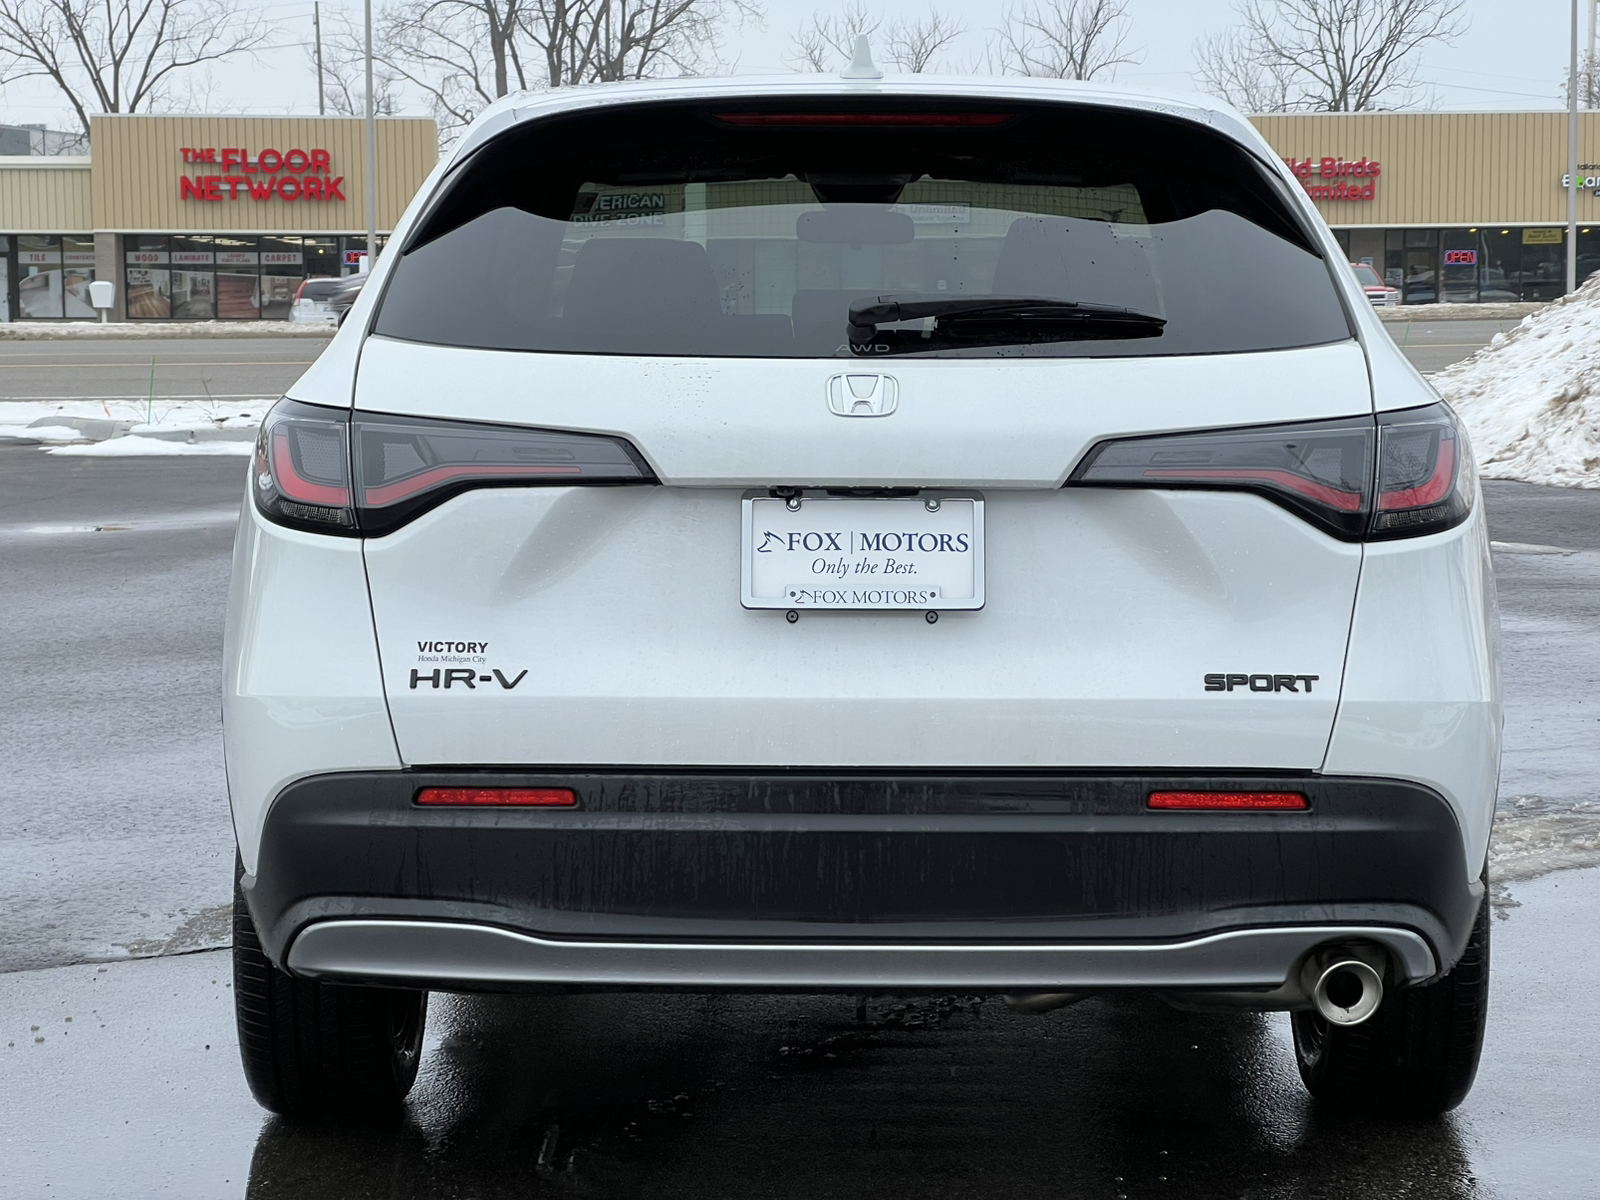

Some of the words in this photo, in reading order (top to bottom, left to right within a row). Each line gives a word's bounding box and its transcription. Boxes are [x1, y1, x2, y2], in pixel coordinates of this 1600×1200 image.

[179, 147, 216, 163] THE
[221, 148, 331, 174] FLOOR
[1282, 156, 1312, 178] ild
[1320, 156, 1381, 178] Birds
[179, 175, 346, 202] NETWORK
[596, 194, 664, 210] ERICAN
[29, 253, 46, 262] TILE
[134, 254, 159, 262] WOOD
[174, 254, 210, 262] LAMINATE
[264, 253, 297, 263] CARPET
[1445, 251, 1476, 264] OPEN
[835, 344, 890, 353] AWD
[787, 531, 843, 552] FOX
[859, 531, 969, 553] MOTORS
[811, 557, 850, 579] Only
[854, 557, 878, 574] the
[883, 557, 918, 575] Best.
[813, 590, 848, 604] FOX
[852, 590, 928, 604] MOTORS
[417, 641, 489, 654] VICTORY
[441, 655, 471, 664] Michigan
[472, 656, 487, 665] City
[409, 668, 529, 690] HR-V
[1203, 673, 1320, 693] SPORT
